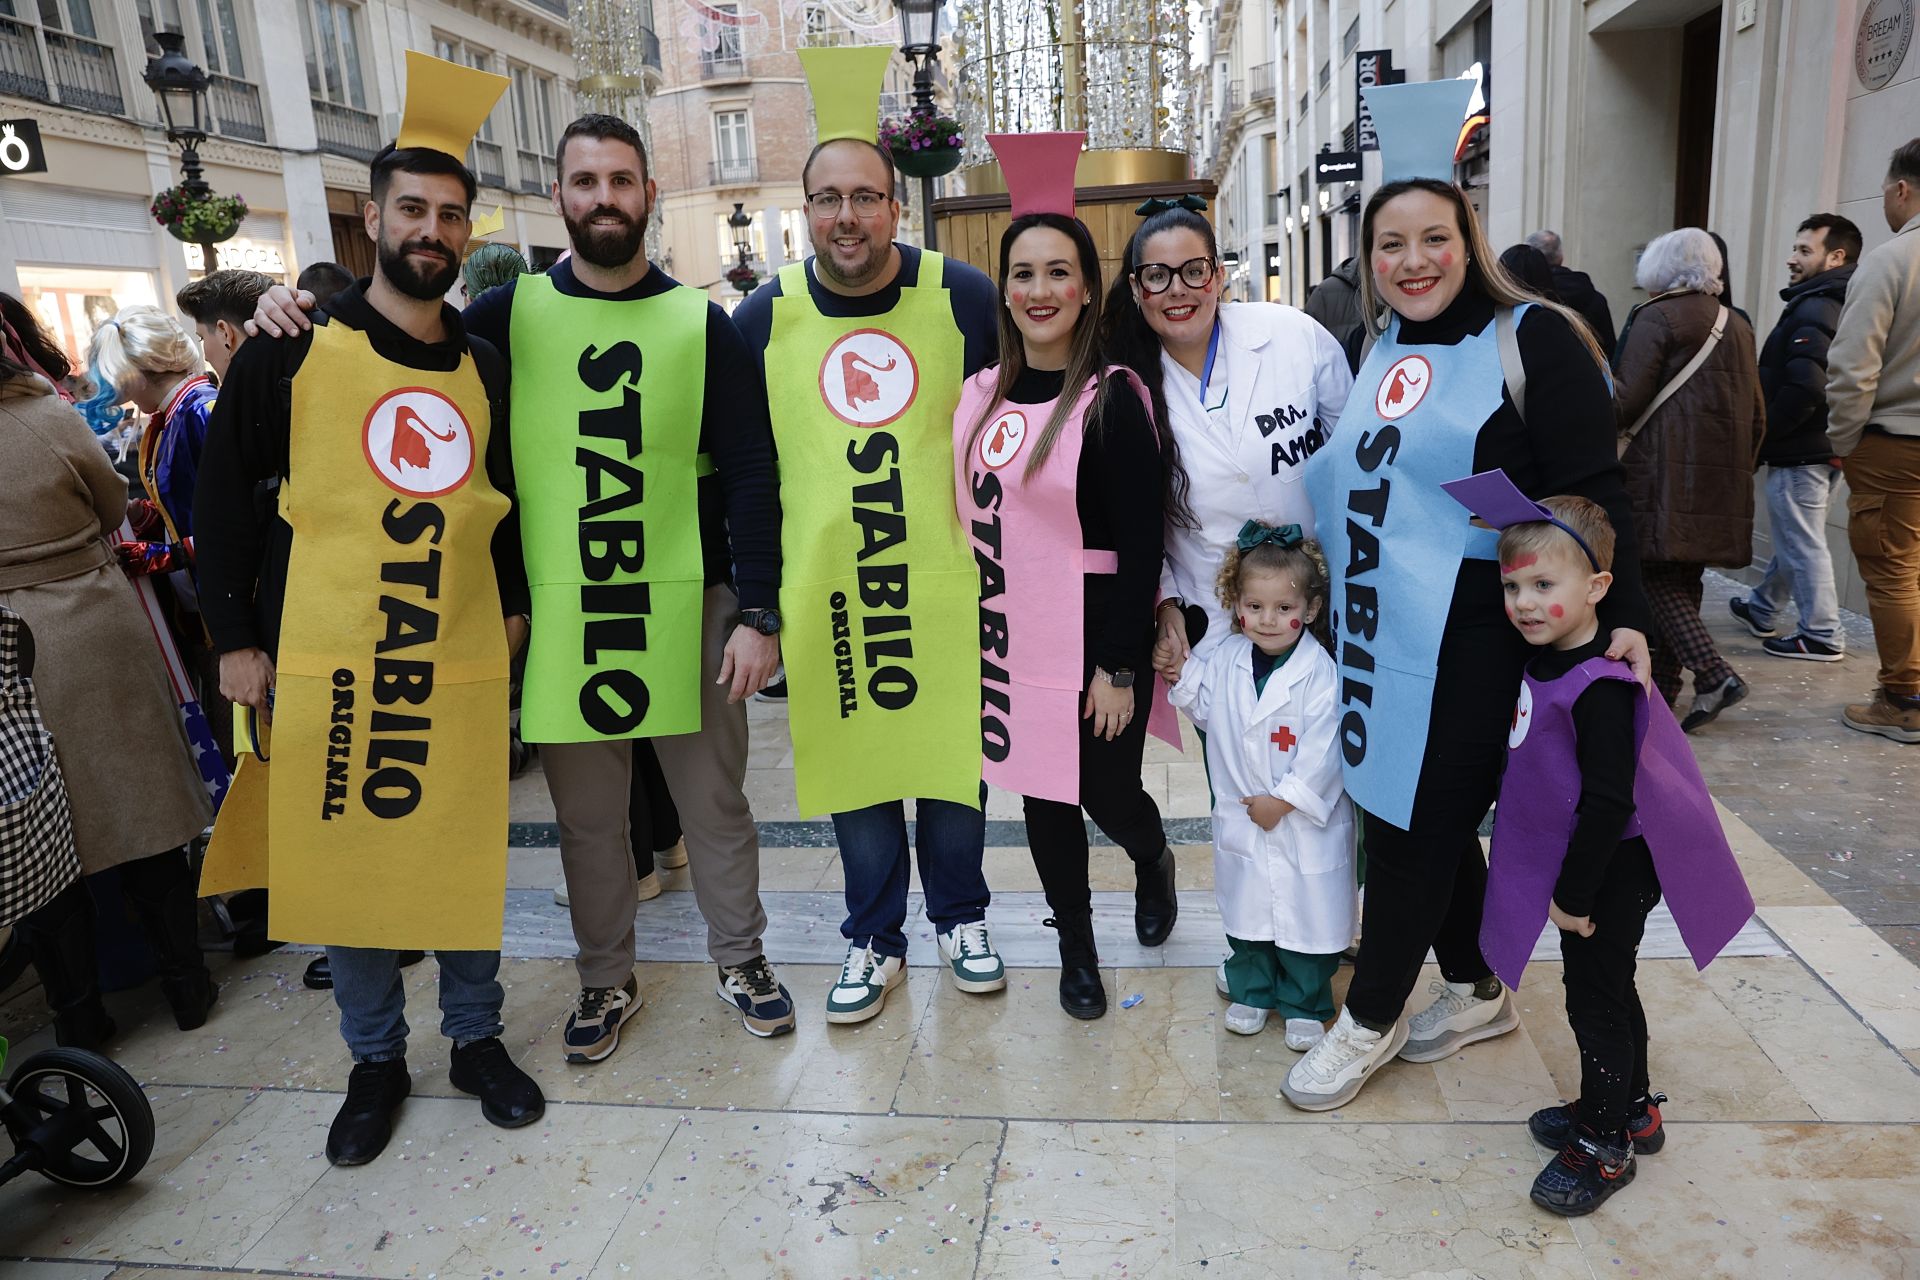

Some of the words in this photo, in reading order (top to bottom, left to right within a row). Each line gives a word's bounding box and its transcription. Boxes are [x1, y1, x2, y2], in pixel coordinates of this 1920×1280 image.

[1867, 13, 1902, 41] BREEAM
[575, 340, 652, 736] STABILO
[1254, 403, 1308, 438] DRA.
[361, 497, 446, 819] STABILO
[829, 591, 858, 719] ORIGINAL
[846, 431, 919, 711] STABILO
[971, 470, 1011, 763] STABILO
[1340, 424, 1401, 767] STABILO
[322, 668, 355, 821] ORIGINAL
